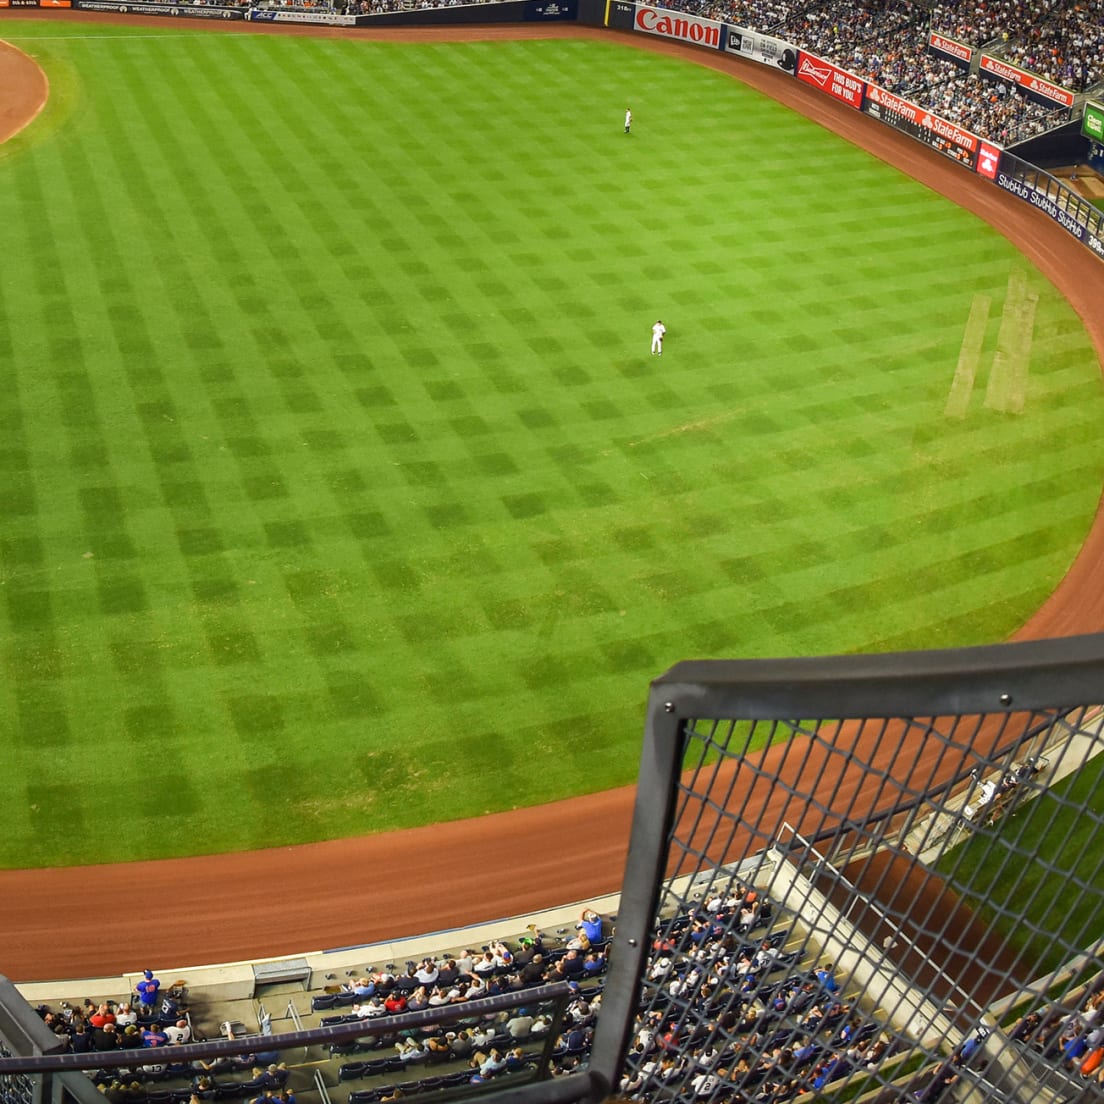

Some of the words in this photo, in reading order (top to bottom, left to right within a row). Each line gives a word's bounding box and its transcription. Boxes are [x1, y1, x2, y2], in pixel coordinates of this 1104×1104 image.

[636, 8, 720, 46] Canon
[803, 61, 827, 81] Budweiser
[831, 83, 842, 96] FOR
[842, 88, 855, 103] YOU.
[833, 71, 845, 85] THIS
[845, 76, 862, 94] BUD'S
[998, 174, 1029, 199] StubHub
[1030, 192, 1057, 218] StubHub
[1057, 210, 1082, 238] StubHub
[176, 1033, 184, 1042] 2
[152, 1065, 162, 1073] 13
[704, 1082, 712, 1091] 2
